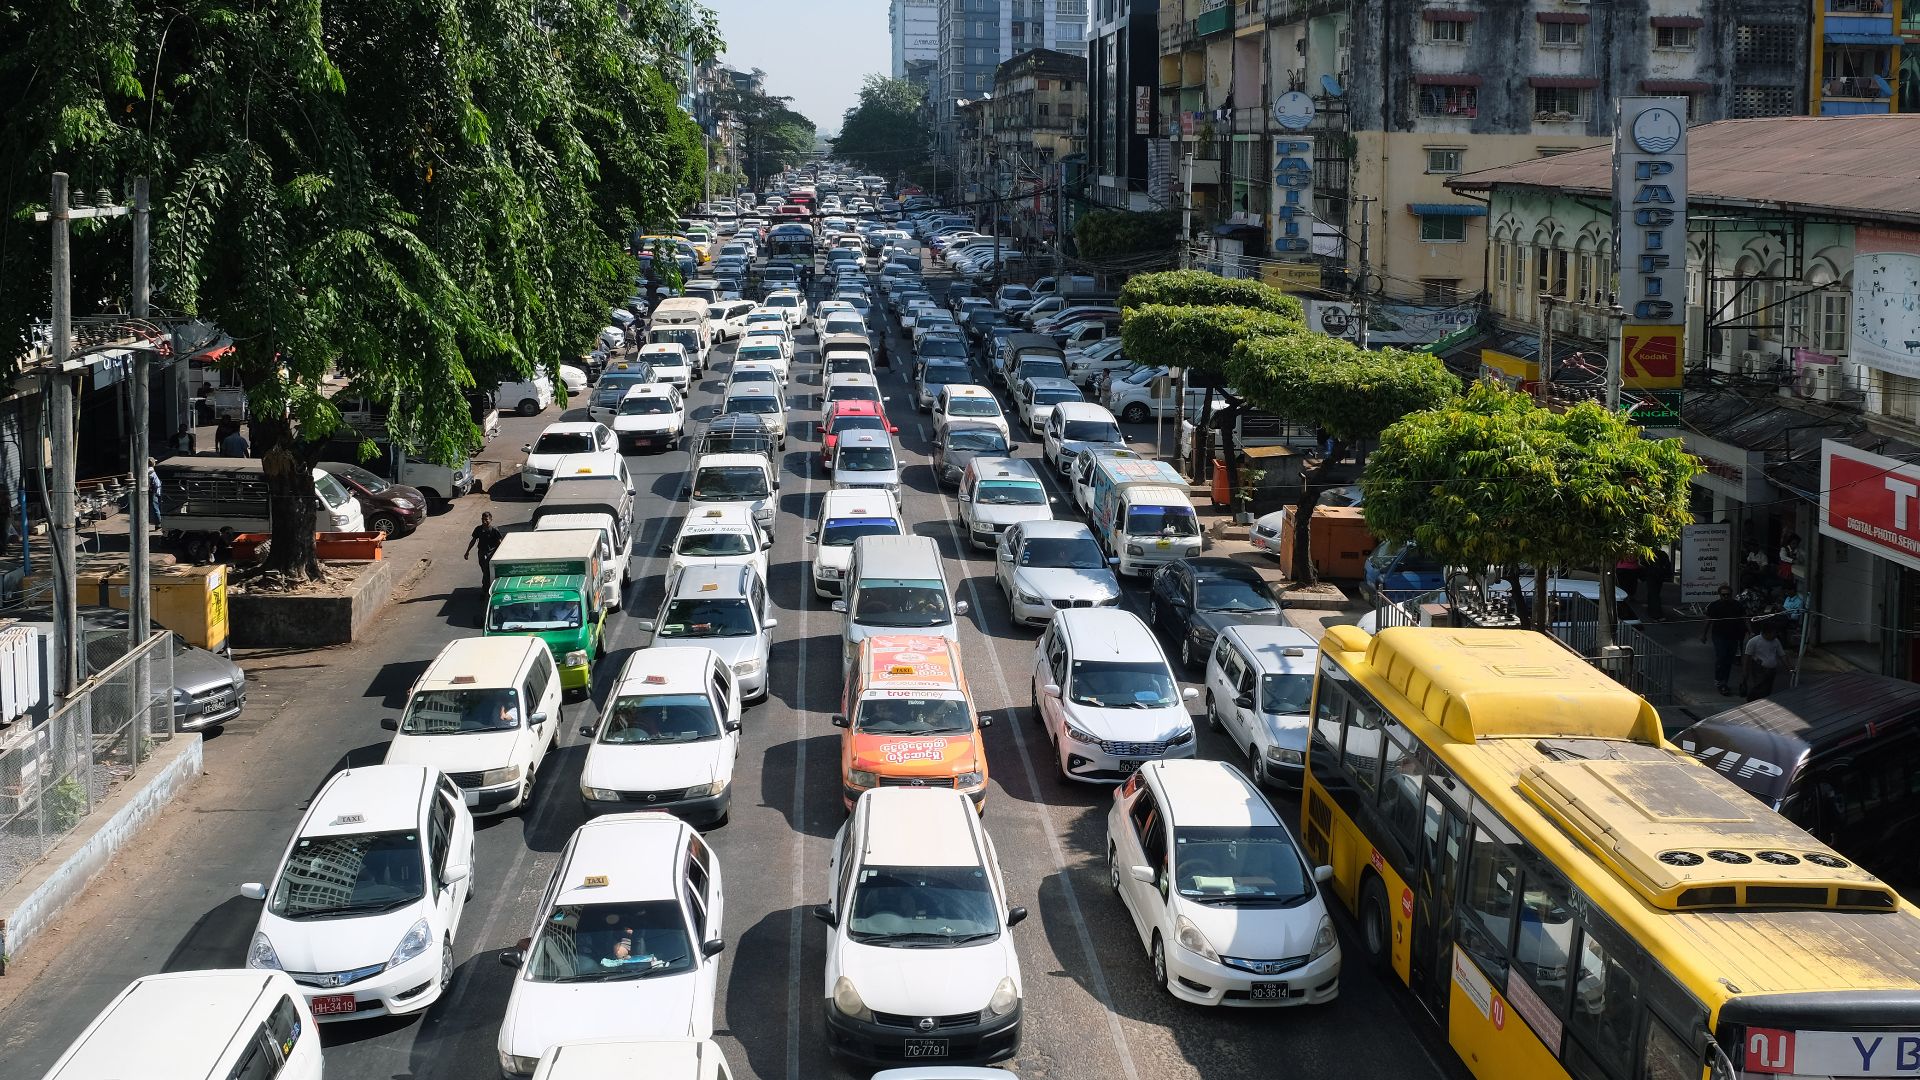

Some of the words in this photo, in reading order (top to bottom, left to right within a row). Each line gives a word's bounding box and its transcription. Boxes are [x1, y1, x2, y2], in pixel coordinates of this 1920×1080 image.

[1274, 140, 1312, 252] PACIFIC
[1633, 160, 1675, 320] PACIFIC
[1288, 270, 1320, 279] Express
[1847, 517, 1873, 537] DIGITAL
[1874, 527, 1897, 545] PHOTO
[1682, 740, 1784, 779] VIP
[907, 1045, 945, 1056] 7G-7791
